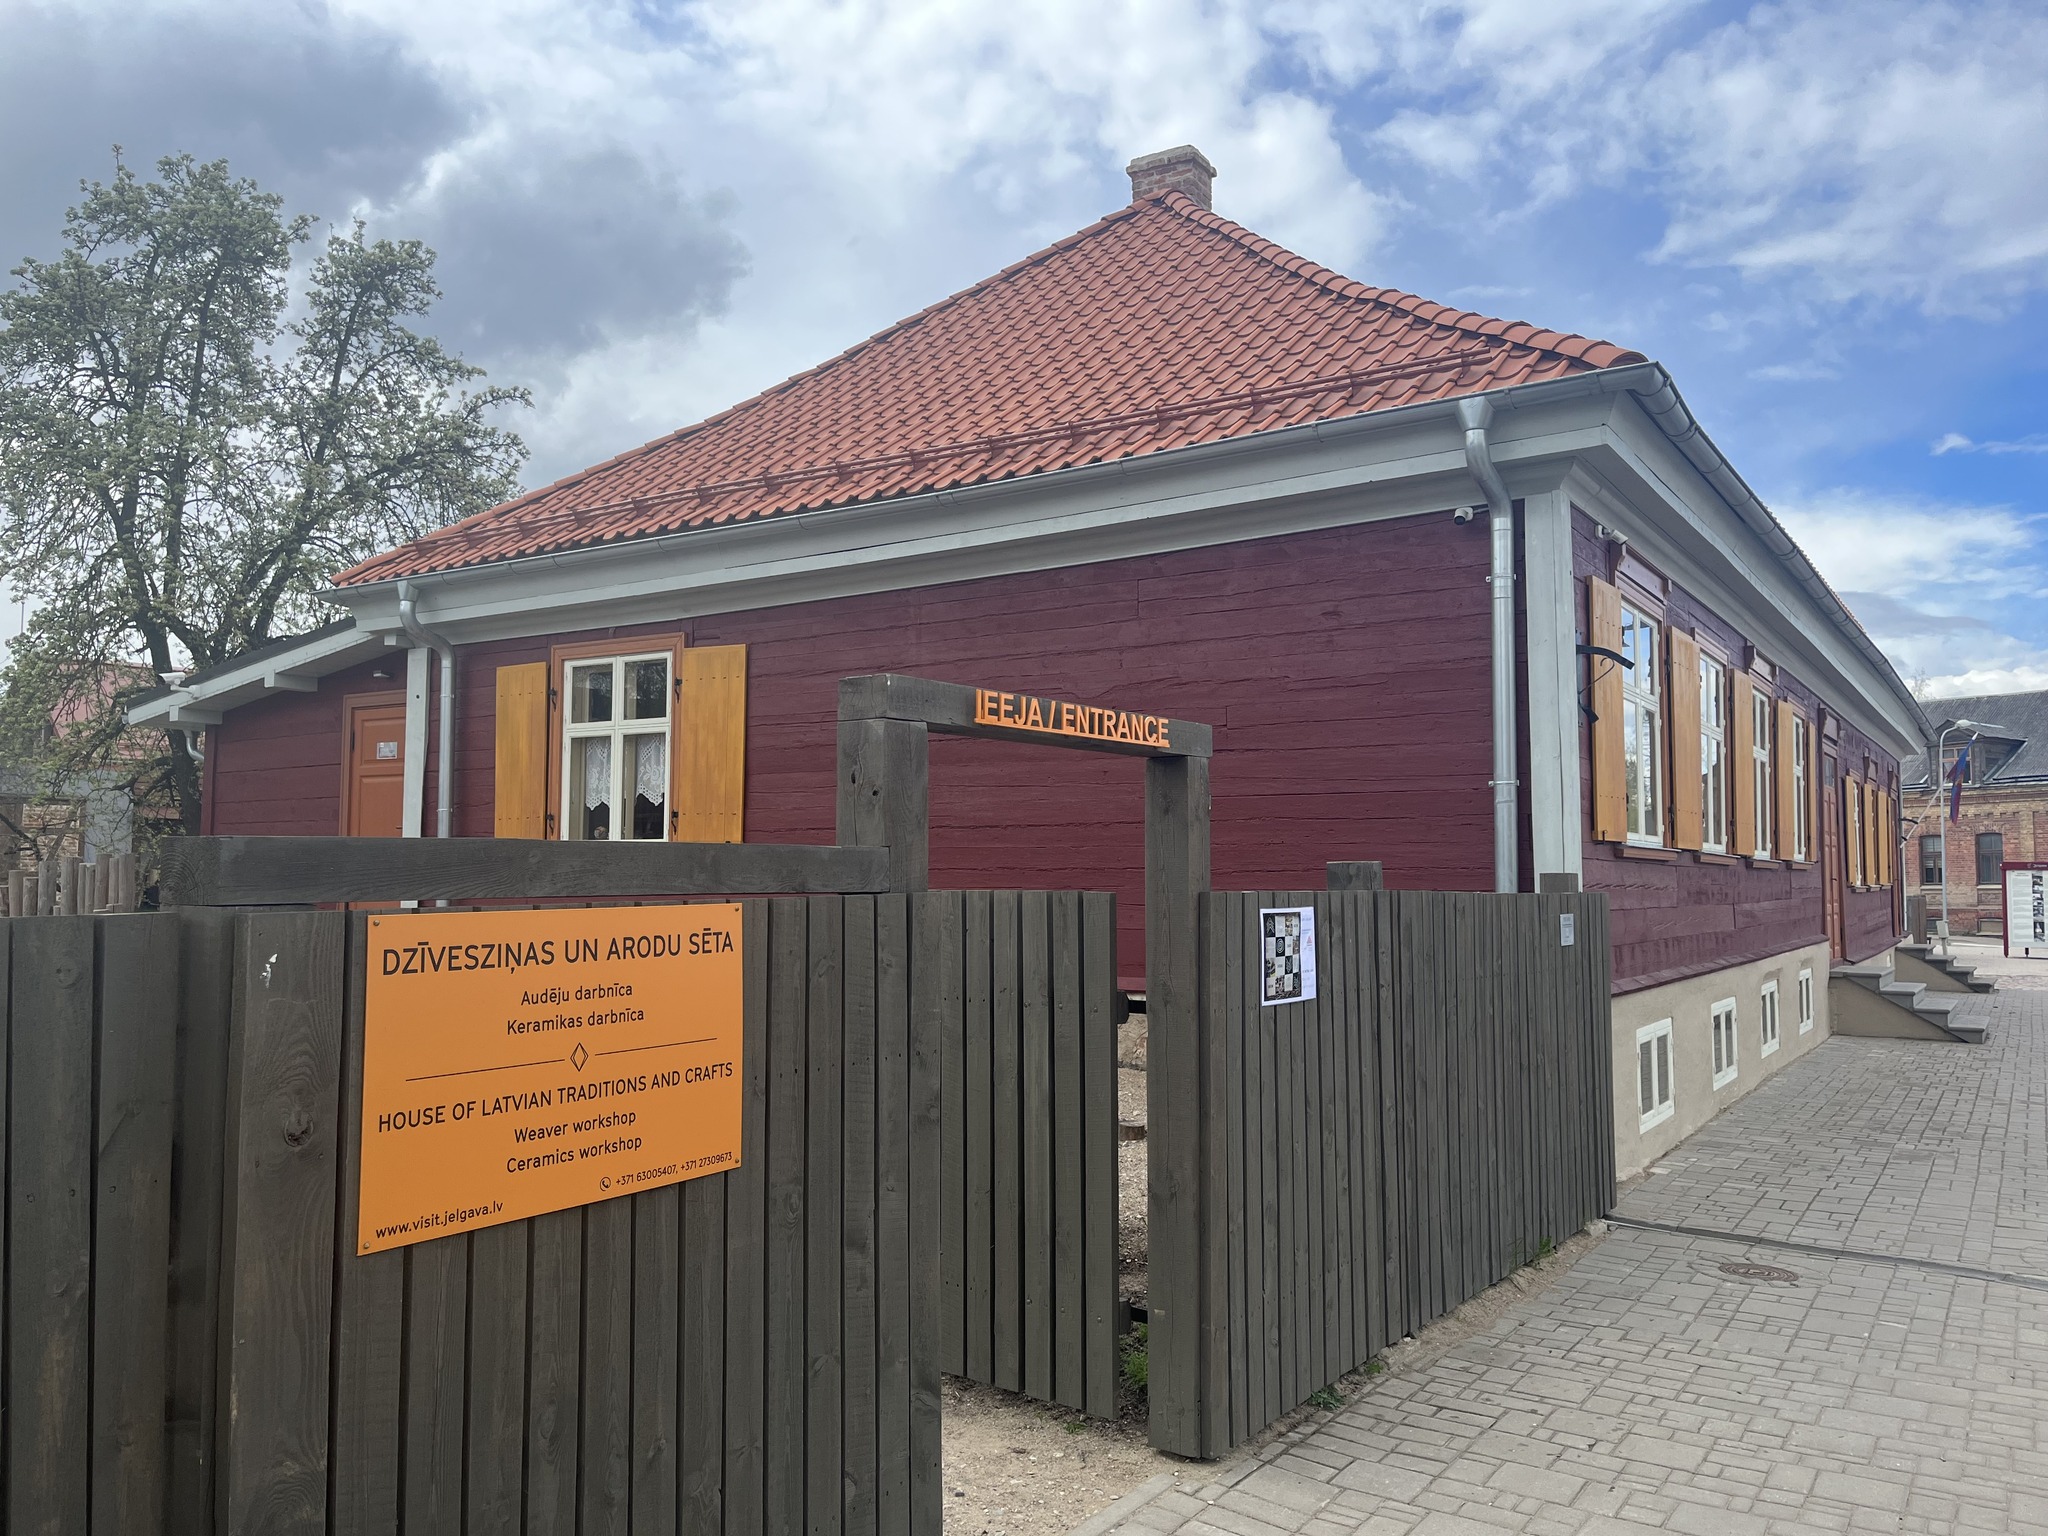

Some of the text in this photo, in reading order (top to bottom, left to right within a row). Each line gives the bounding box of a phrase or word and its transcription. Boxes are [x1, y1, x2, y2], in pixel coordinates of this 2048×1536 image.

[975, 689, 1169, 745] IEEJA / ENTRANCE
[383, 928, 733, 975] DZĪVESZIŅAS UN ARODU SĒTA
[521, 983, 632, 1005] Audēju darbnīca
[508, 1008, 644, 1035] Keramikas darbnīca
[379, 1062, 732, 1132] HOUSE OF LATVIAN TRADITIONS AND CRAFTS
[515, 1112, 636, 1143] Weaver workshop
[507, 1137, 641, 1173] Ceramics workshop
[616, 1152, 733, 1186] +371 63005407, +371 27309673
[376, 1201, 503, 1239] www.visit.jelgava.lv
